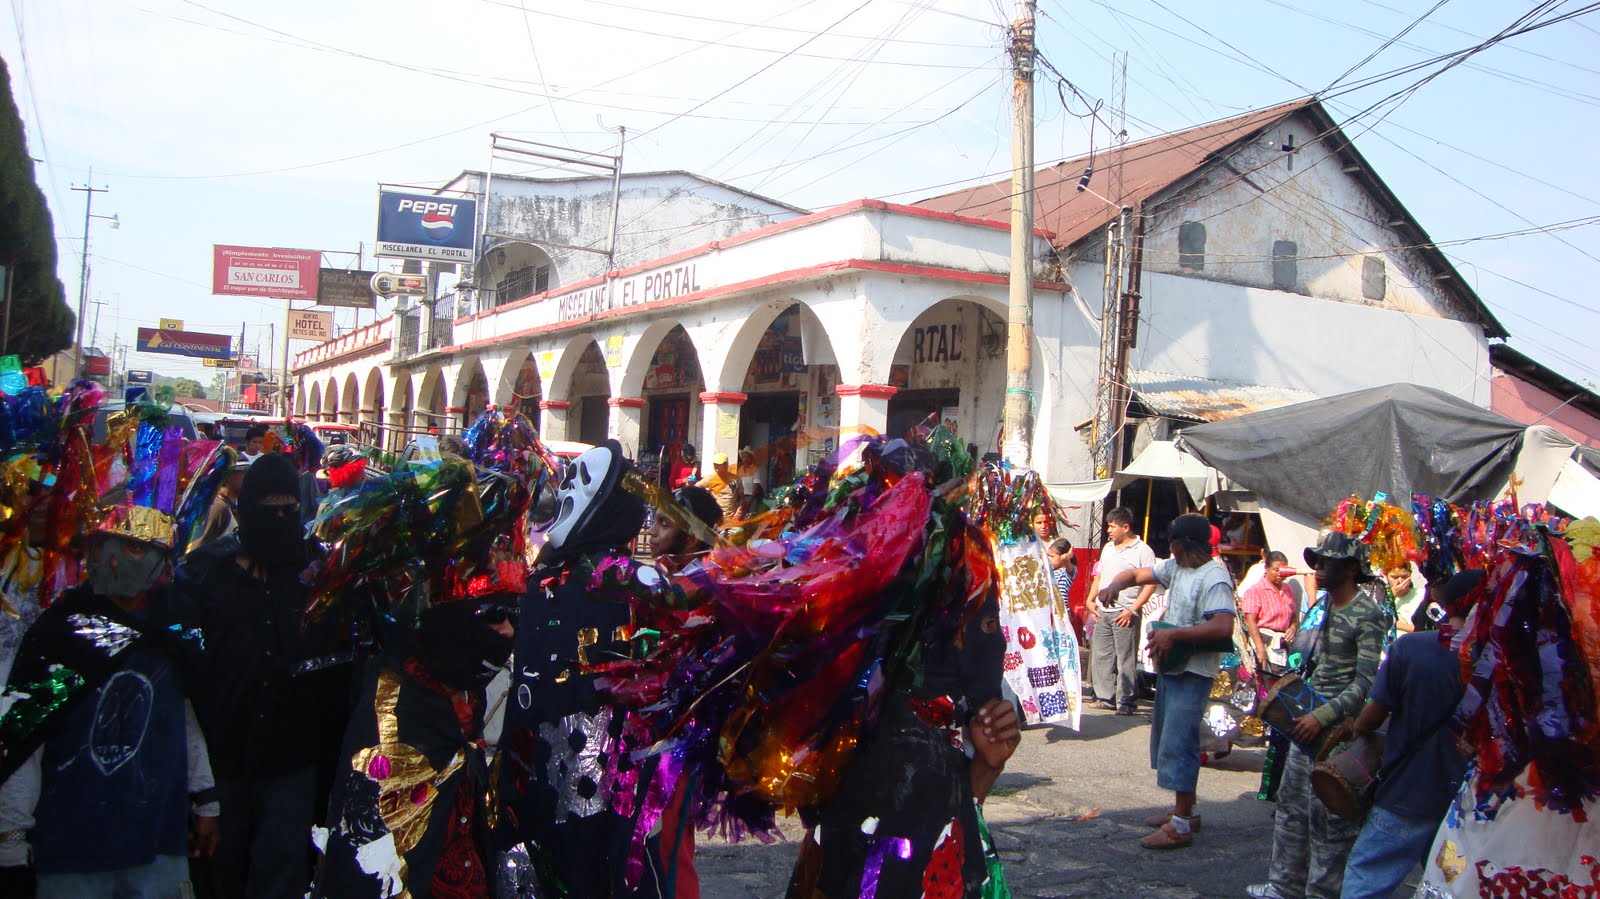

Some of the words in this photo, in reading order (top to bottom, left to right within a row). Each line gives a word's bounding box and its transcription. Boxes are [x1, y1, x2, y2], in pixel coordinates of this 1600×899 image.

[398, 199, 458, 217] PEPSI
[382, 244, 423, 254] MISCELANEA
[428, 247, 437, 255] EL
[441, 249, 467, 257] PORTAL
[234, 271, 255, 282] SAN
[255, 273, 294, 284] CARLOS
[558, 285, 613, 322] MISCELANE
[622, 280, 638, 307] EL
[644, 263, 701, 303] PORTAL
[295, 319, 324, 330] HOTEL
[173, 343, 222, 353] CONTINENTAL
